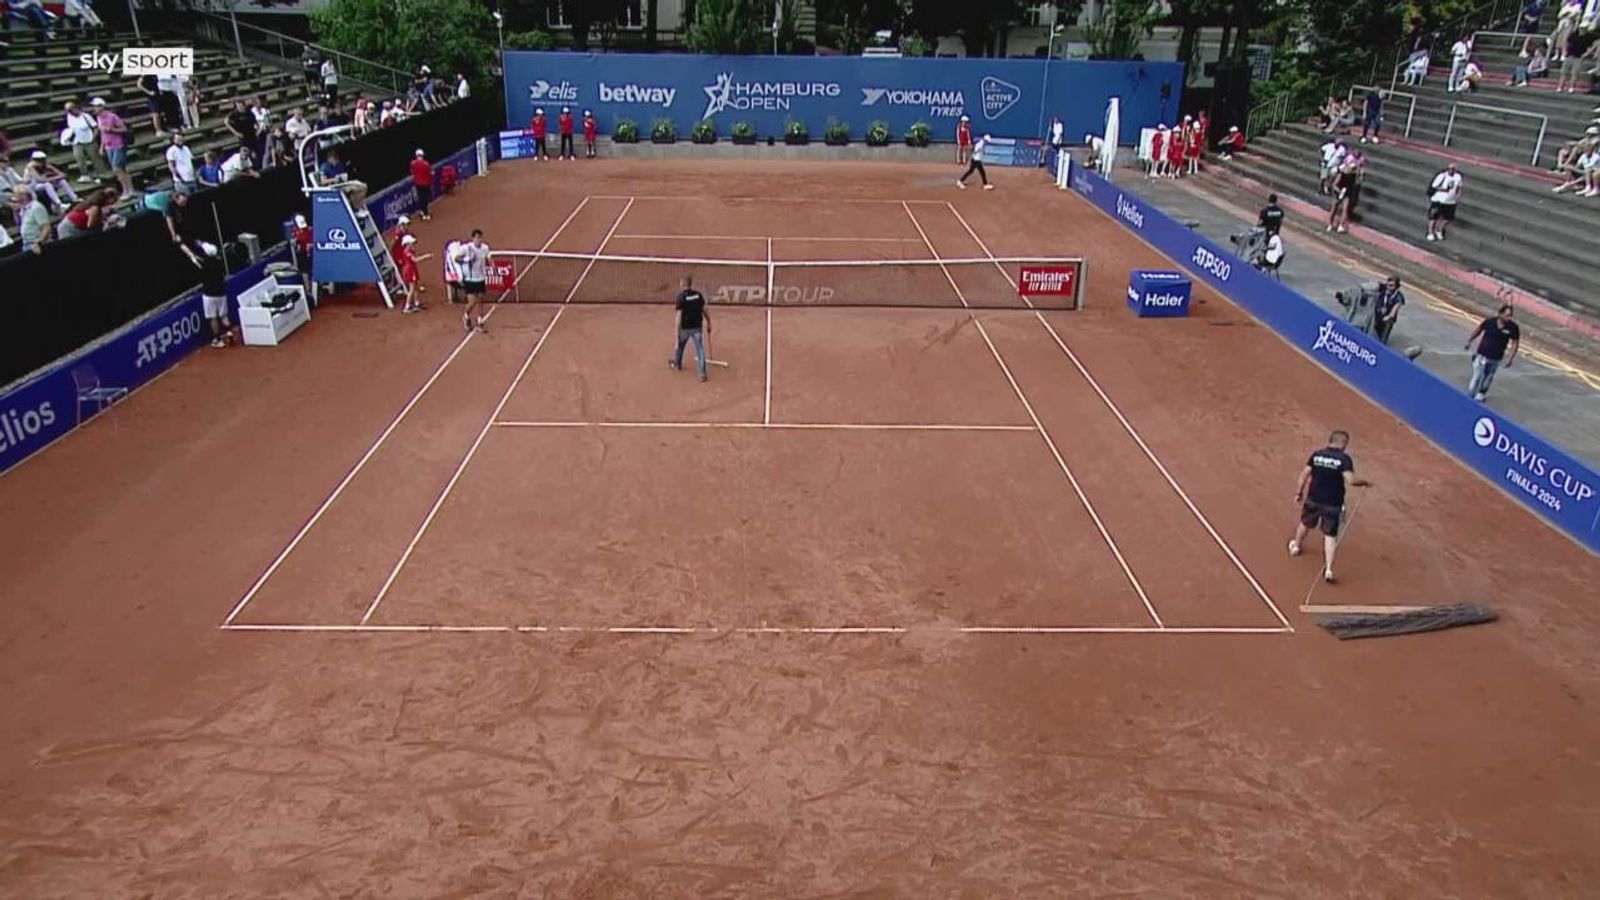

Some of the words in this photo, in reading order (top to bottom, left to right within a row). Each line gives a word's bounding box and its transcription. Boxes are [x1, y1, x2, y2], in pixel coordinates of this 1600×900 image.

[548, 80, 578, 99] elis
[599, 83, 676, 106] betway
[736, 82, 841, 97] HAMBURG
[886, 91, 964, 105] YOKOHAMA
[986, 94, 1013, 102] ACTIVE
[736, 97, 790, 111] OPEN
[930, 106, 964, 117] TYRES
[986, 102, 1004, 110] CITY
[1121, 199, 1144, 228] Helios
[316, 242, 361, 250] LEXUS
[1192, 247, 1230, 281] ATP500
[1022, 270, 1070, 282] Emirates
[712, 285, 766, 303] ATP
[771, 285, 835, 303] TOUR
[1144, 293, 1184, 307] Haier
[136, 311, 200, 368] ATP500
[1331, 330, 1377, 365] HAMBURG
[1327, 341, 1351, 364] OPEN
[1495, 433, 1545, 476] DAVIS
[1549, 468, 1593, 501] CUP
[1506, 468, 1538, 496] FINALS
[1537, 487, 1562, 511] 2024
